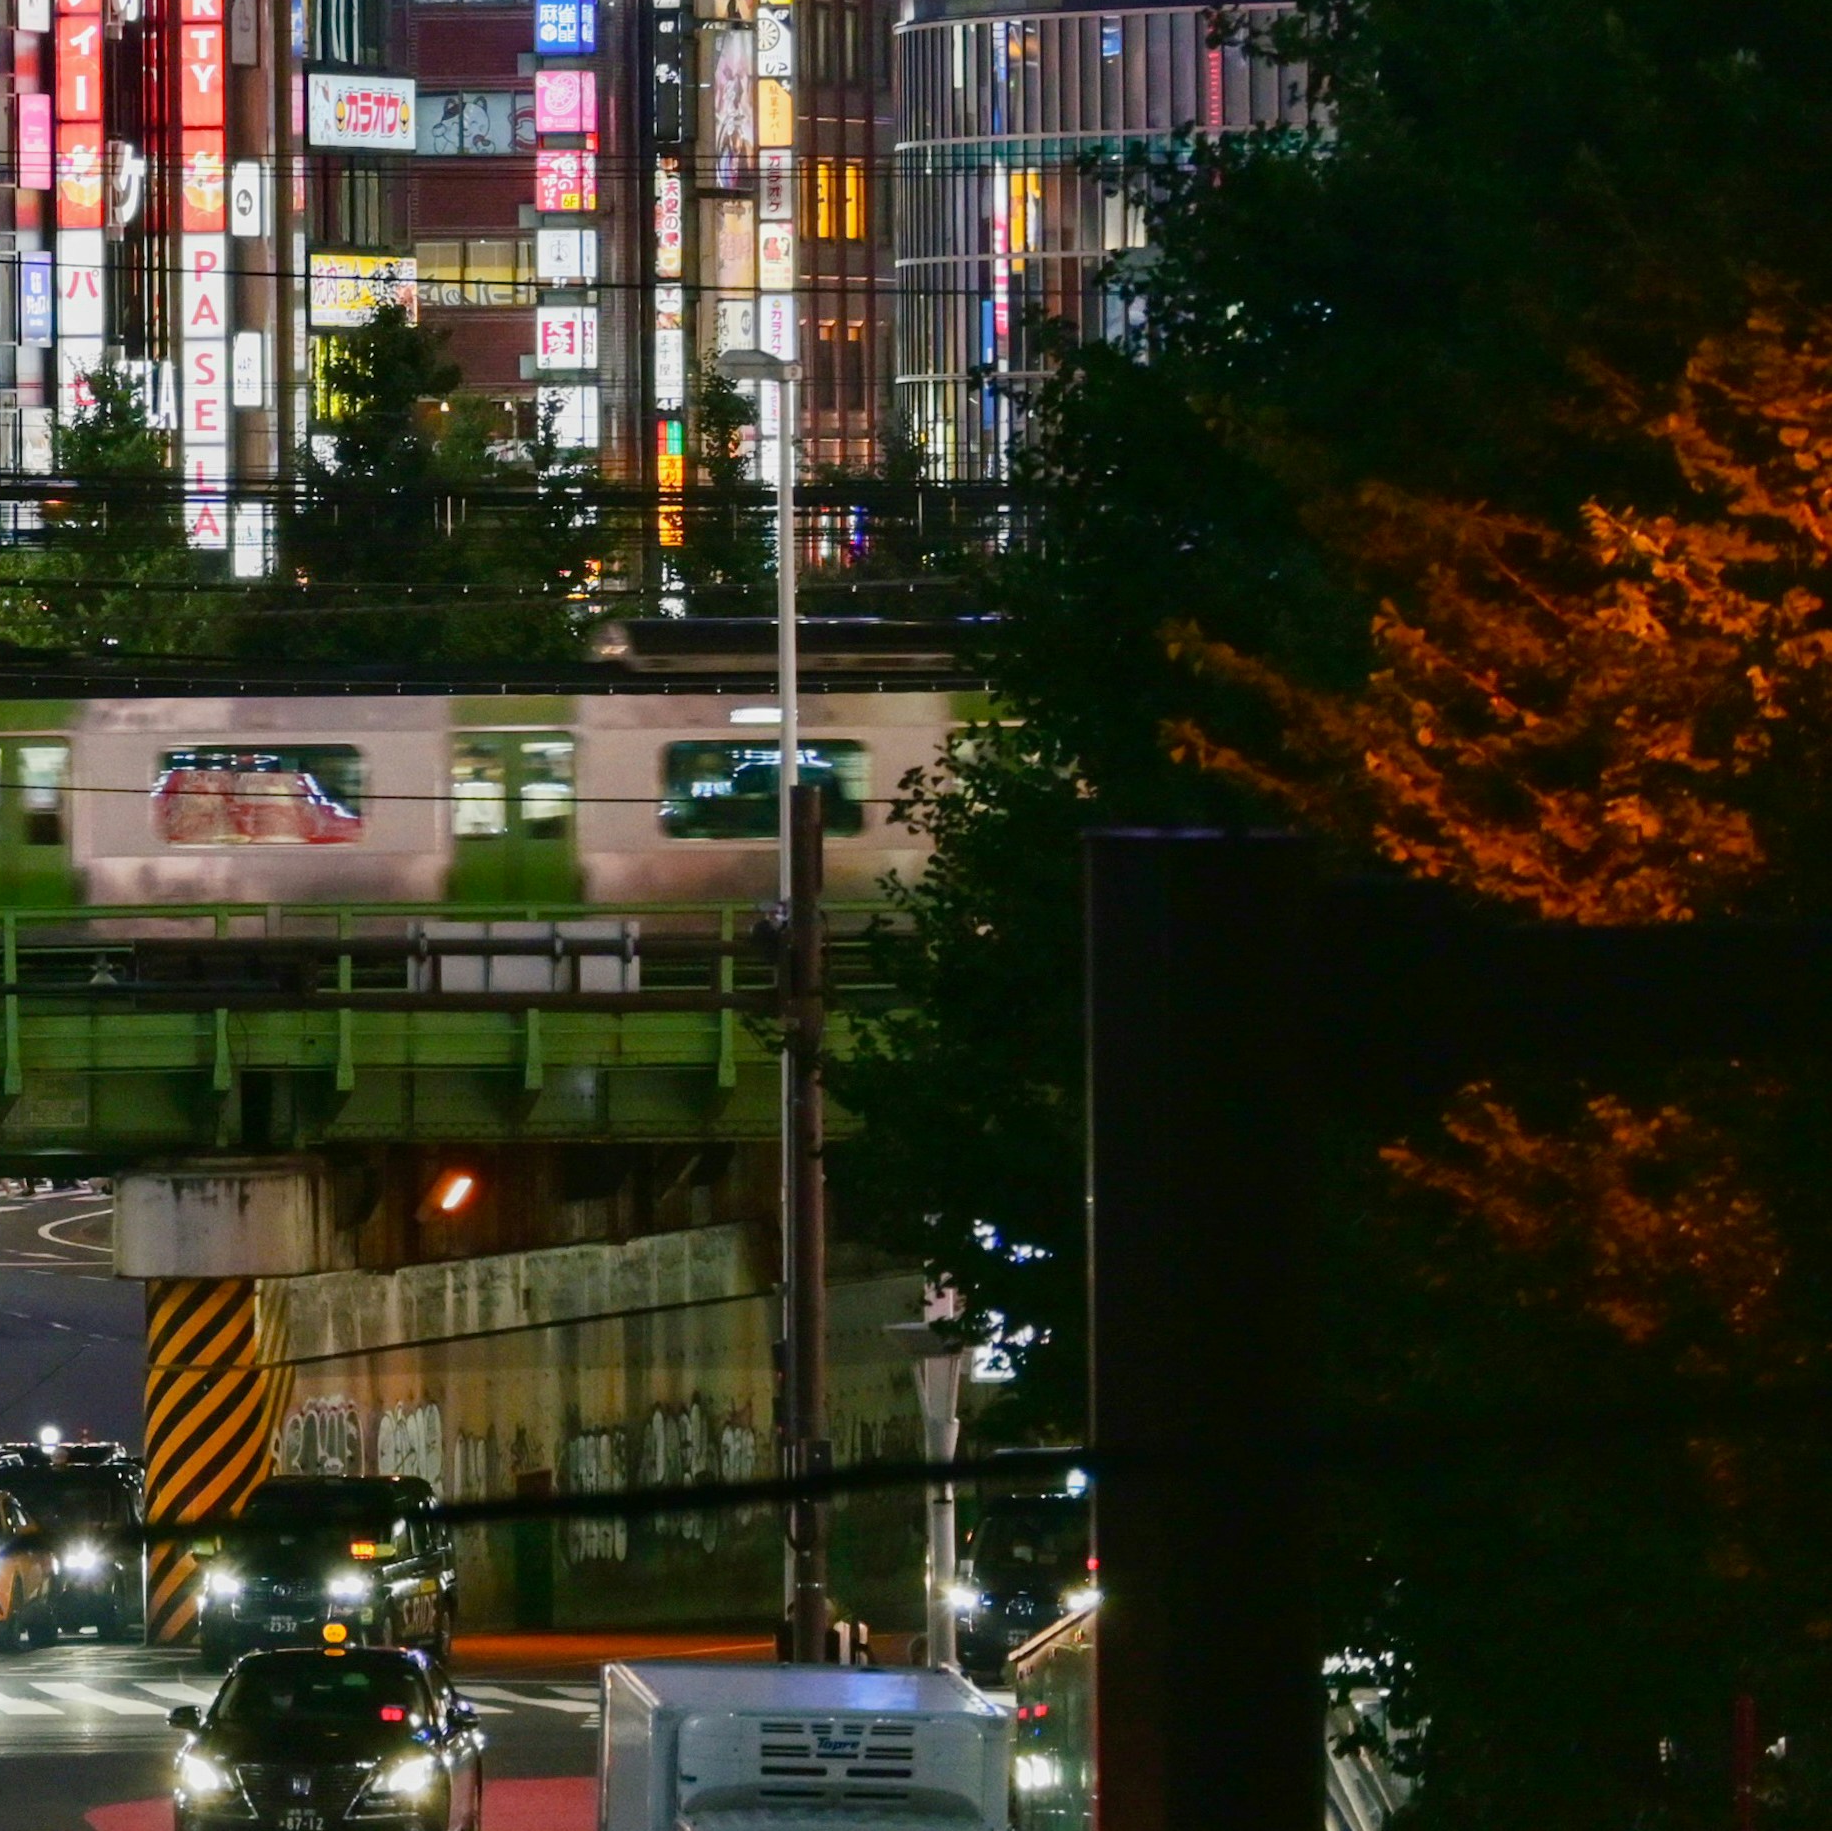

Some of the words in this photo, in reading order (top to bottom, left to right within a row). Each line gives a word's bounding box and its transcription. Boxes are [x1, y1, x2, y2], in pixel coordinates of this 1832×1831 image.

[539, 3, 577, 24] 麻雀
[343, 86, 402, 136] カラオケ
[769, 155, 783, 214] カラオケ
[191, 250, 220, 537] PASELA
[656, 397, 684, 412] 4F
[269, 1620, 300, 1633] 23-37
